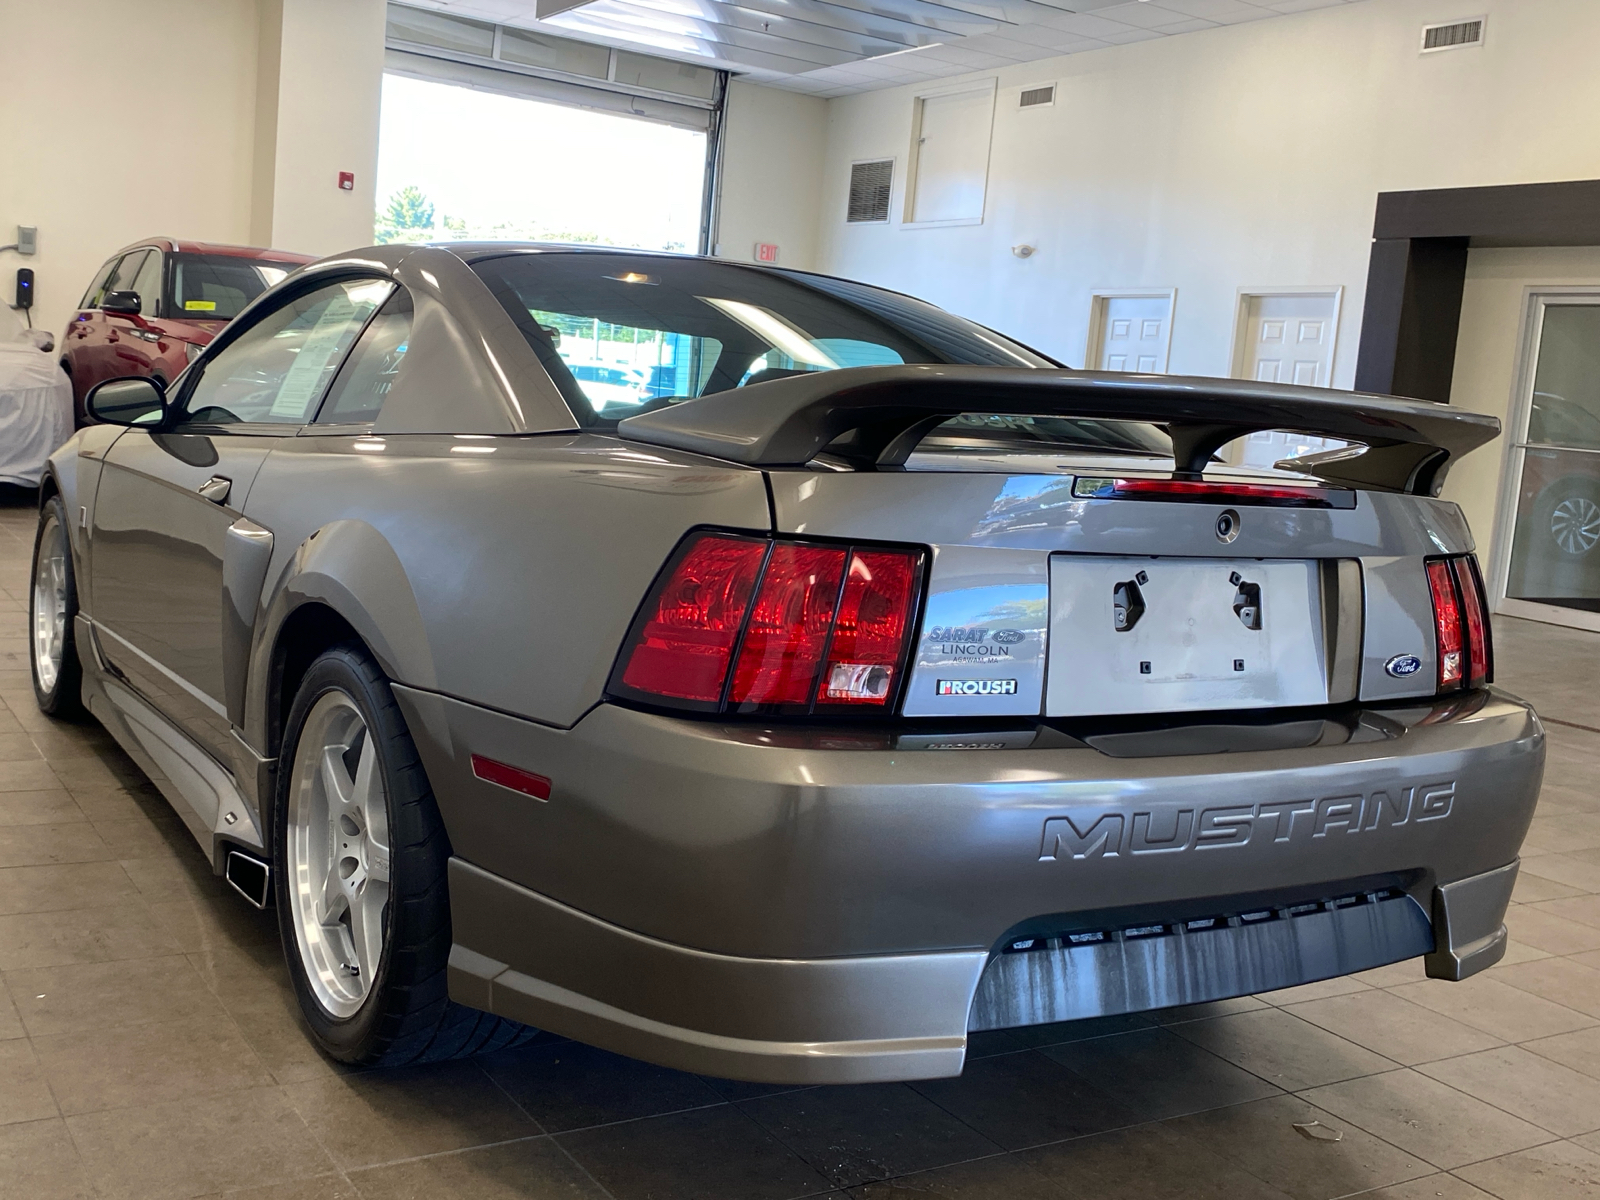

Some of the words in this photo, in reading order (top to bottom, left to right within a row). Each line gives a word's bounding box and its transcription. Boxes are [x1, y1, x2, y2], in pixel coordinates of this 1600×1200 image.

[760, 244, 778, 261] EXIT
[929, 626, 988, 643] SARAT
[941, 644, 1009, 656] LINCOLN
[951, 680, 1016, 694] ROUSH
[1038, 780, 1456, 861] MUSTANG
